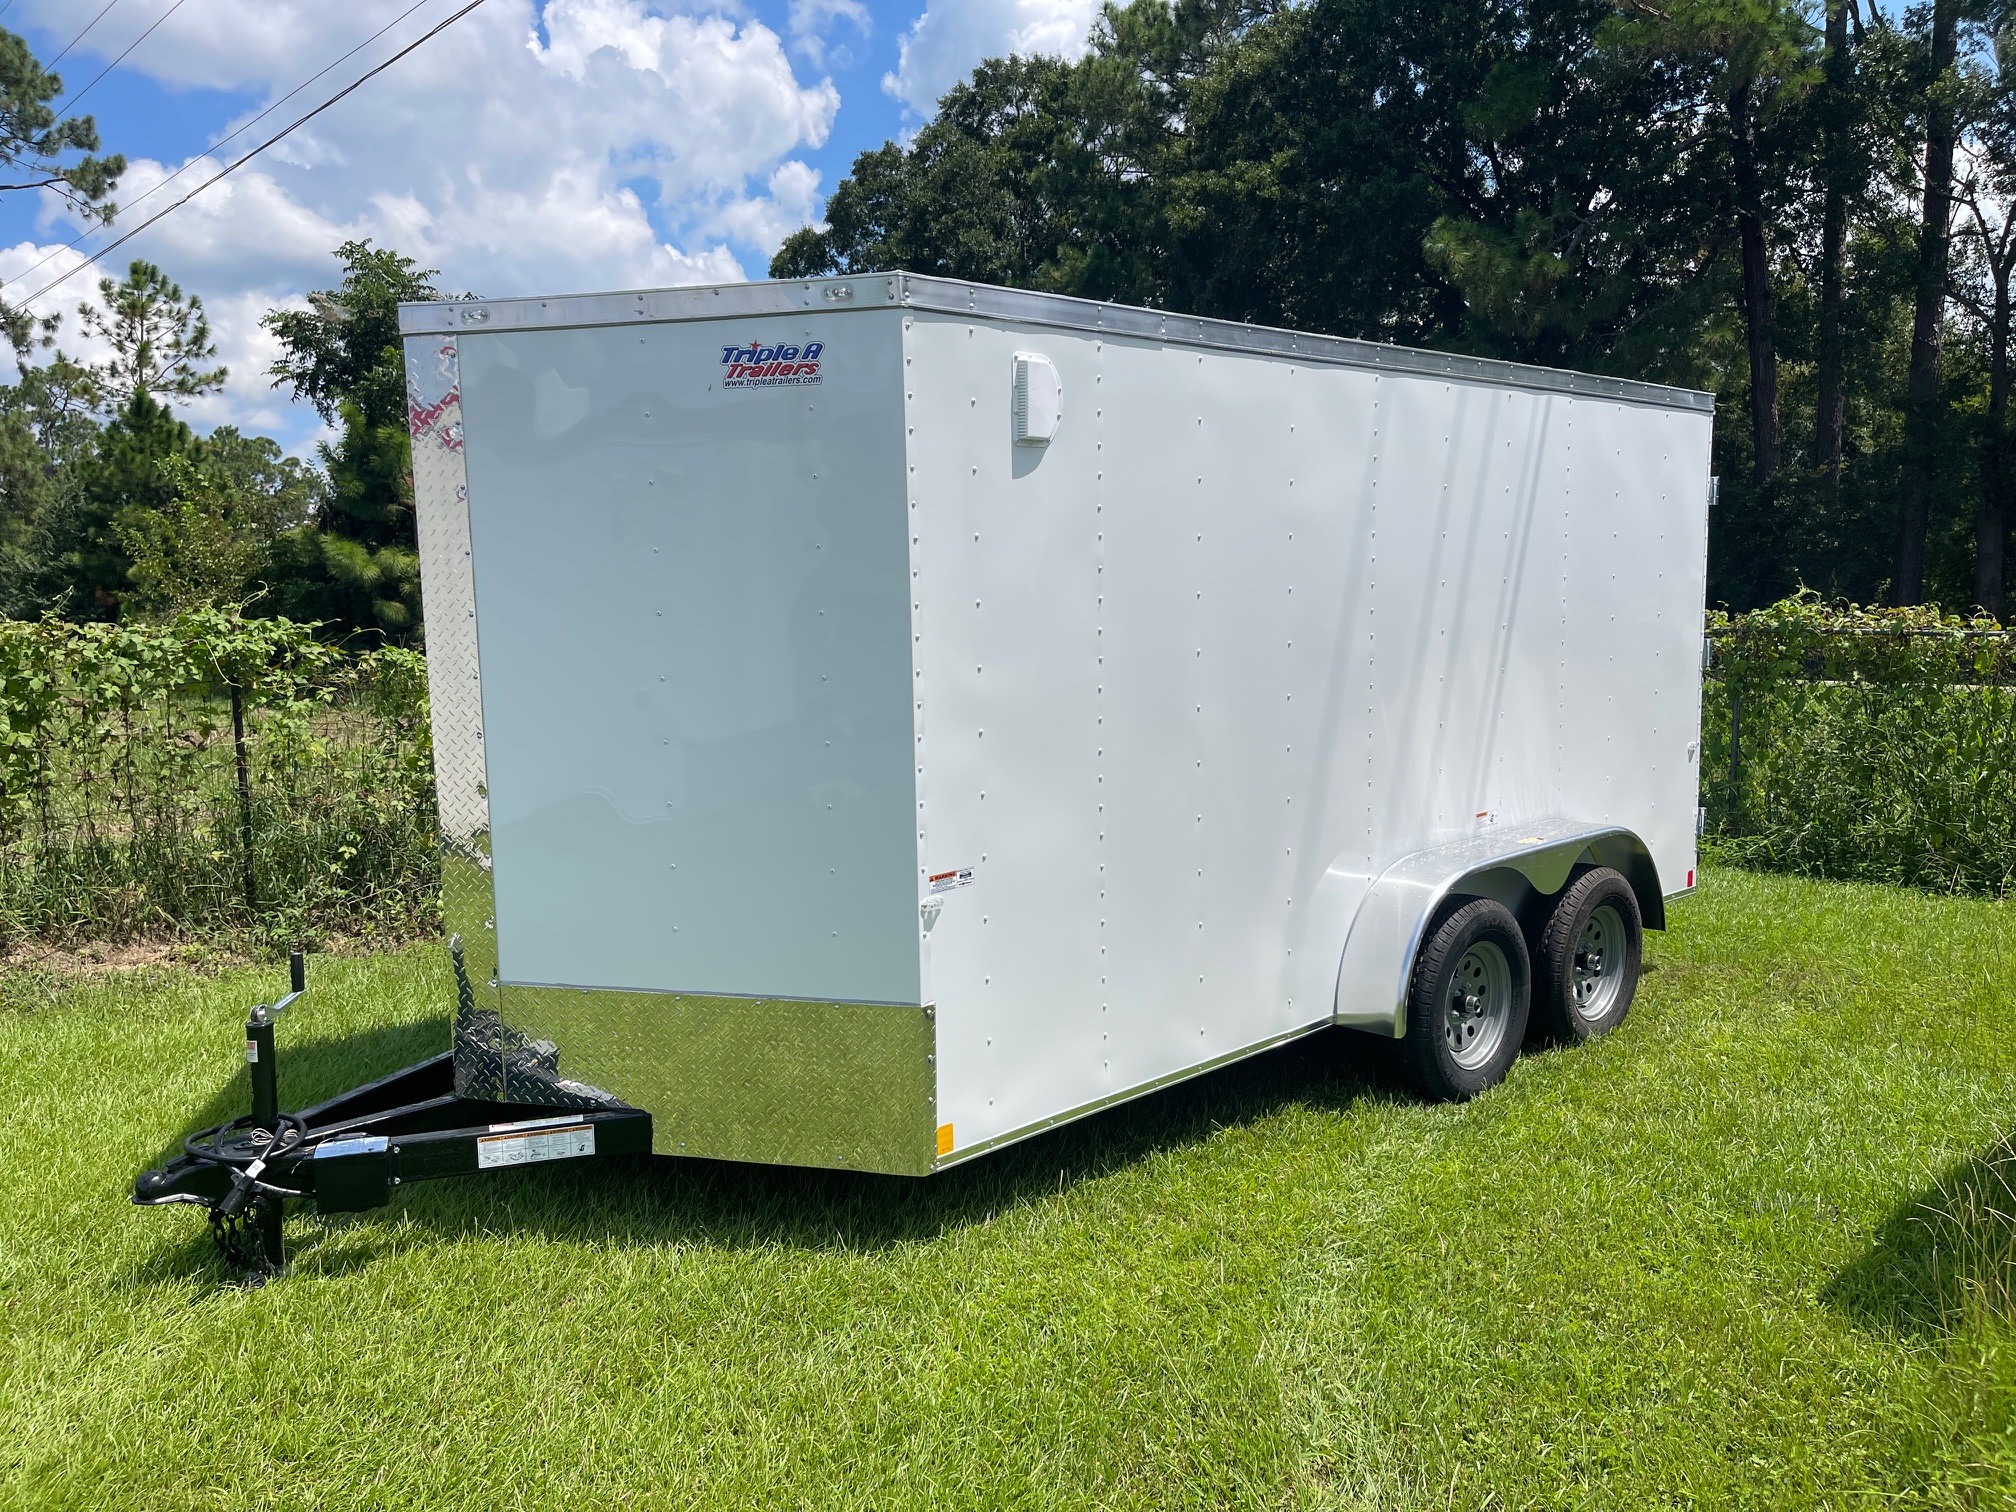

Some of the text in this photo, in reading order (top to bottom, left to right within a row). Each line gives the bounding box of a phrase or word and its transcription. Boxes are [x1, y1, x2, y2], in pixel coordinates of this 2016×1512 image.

[722, 342, 823, 365] Triple A
[727, 362, 820, 379] Trailers
[725, 376, 821, 387] www.tripleatrailers.com
[934, 871, 956, 880] WARNING
